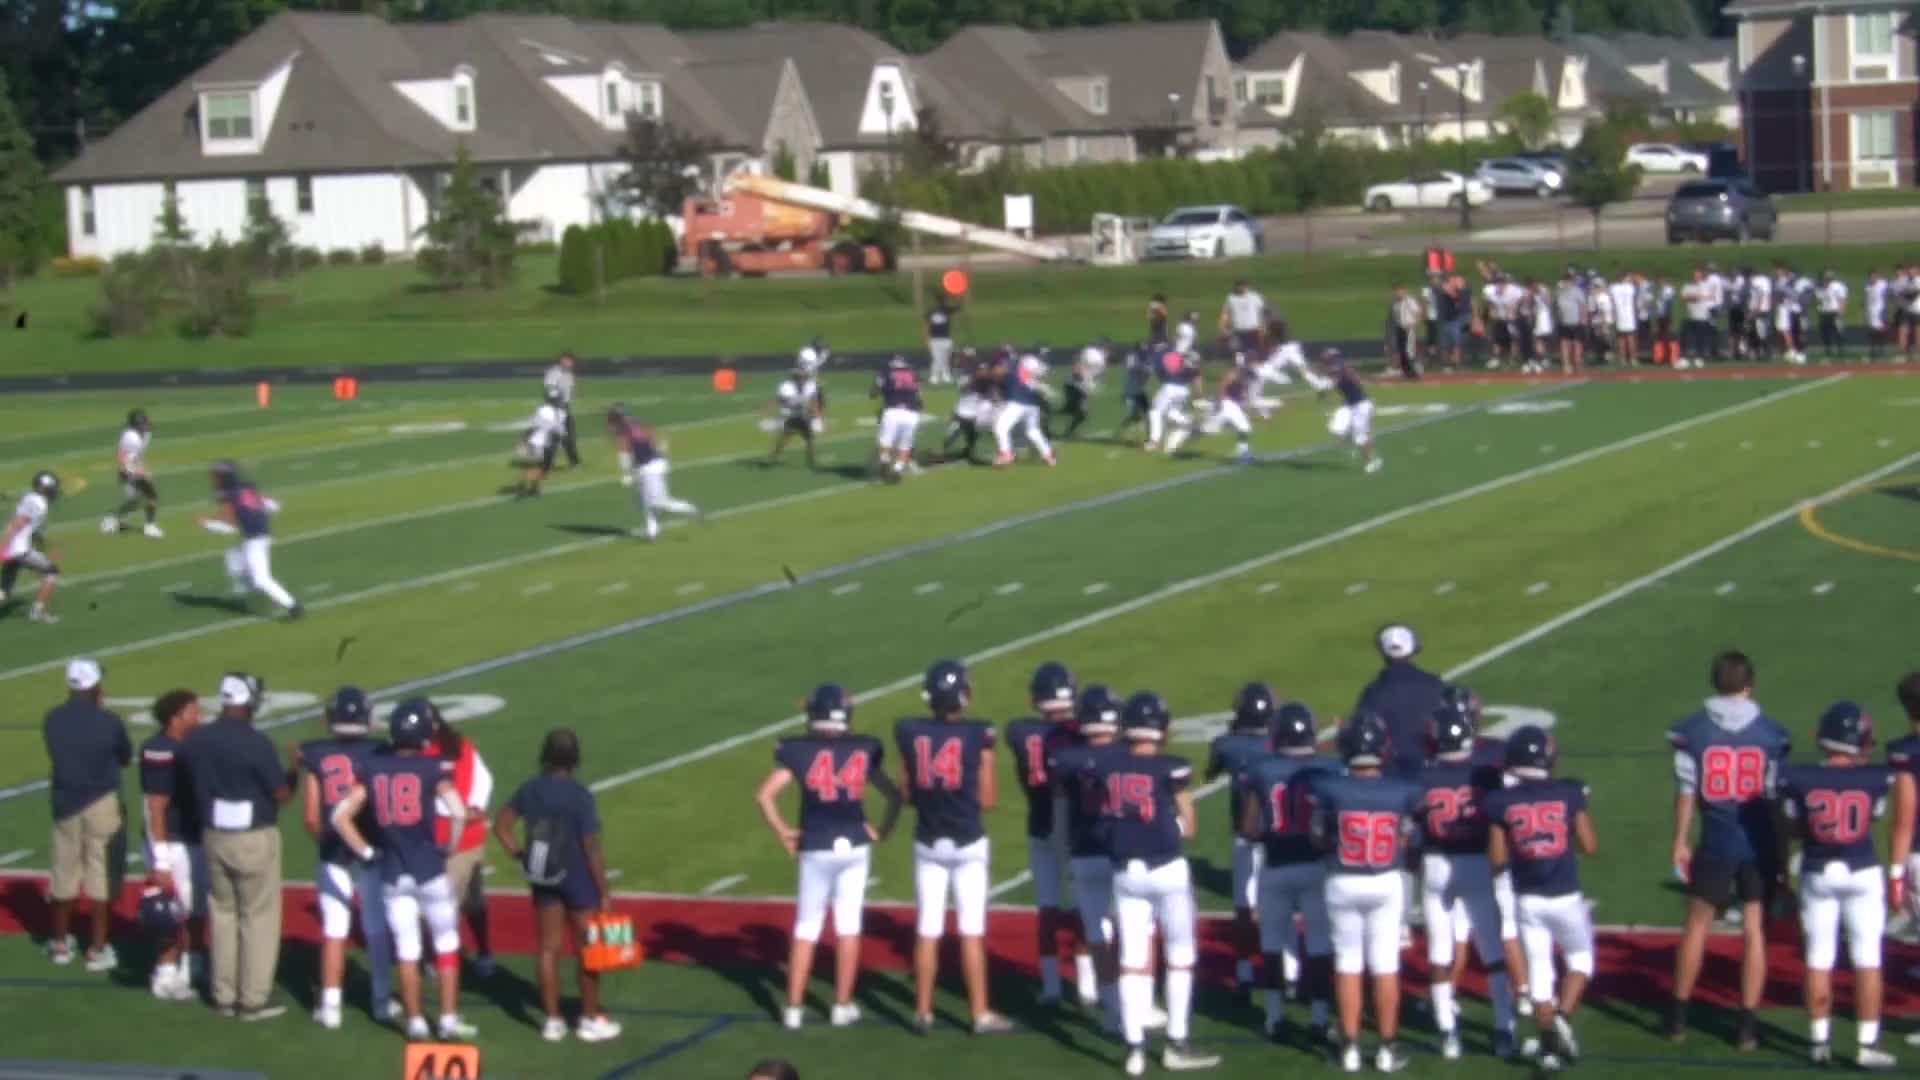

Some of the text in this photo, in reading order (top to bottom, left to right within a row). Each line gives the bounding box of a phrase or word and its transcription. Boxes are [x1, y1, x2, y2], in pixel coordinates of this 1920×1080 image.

[320, 752, 356, 807] 2
[805, 749, 869, 801] 44
[914, 735, 963, 790] 14
[1025, 734, 1048, 786] 1
[1702, 745, 1766, 803] 88
[372, 771, 422, 827] 18
[1805, 789, 1871, 845] 20
[1338, 809, 1399, 867] 56
[1504, 800, 1568, 860] 25
